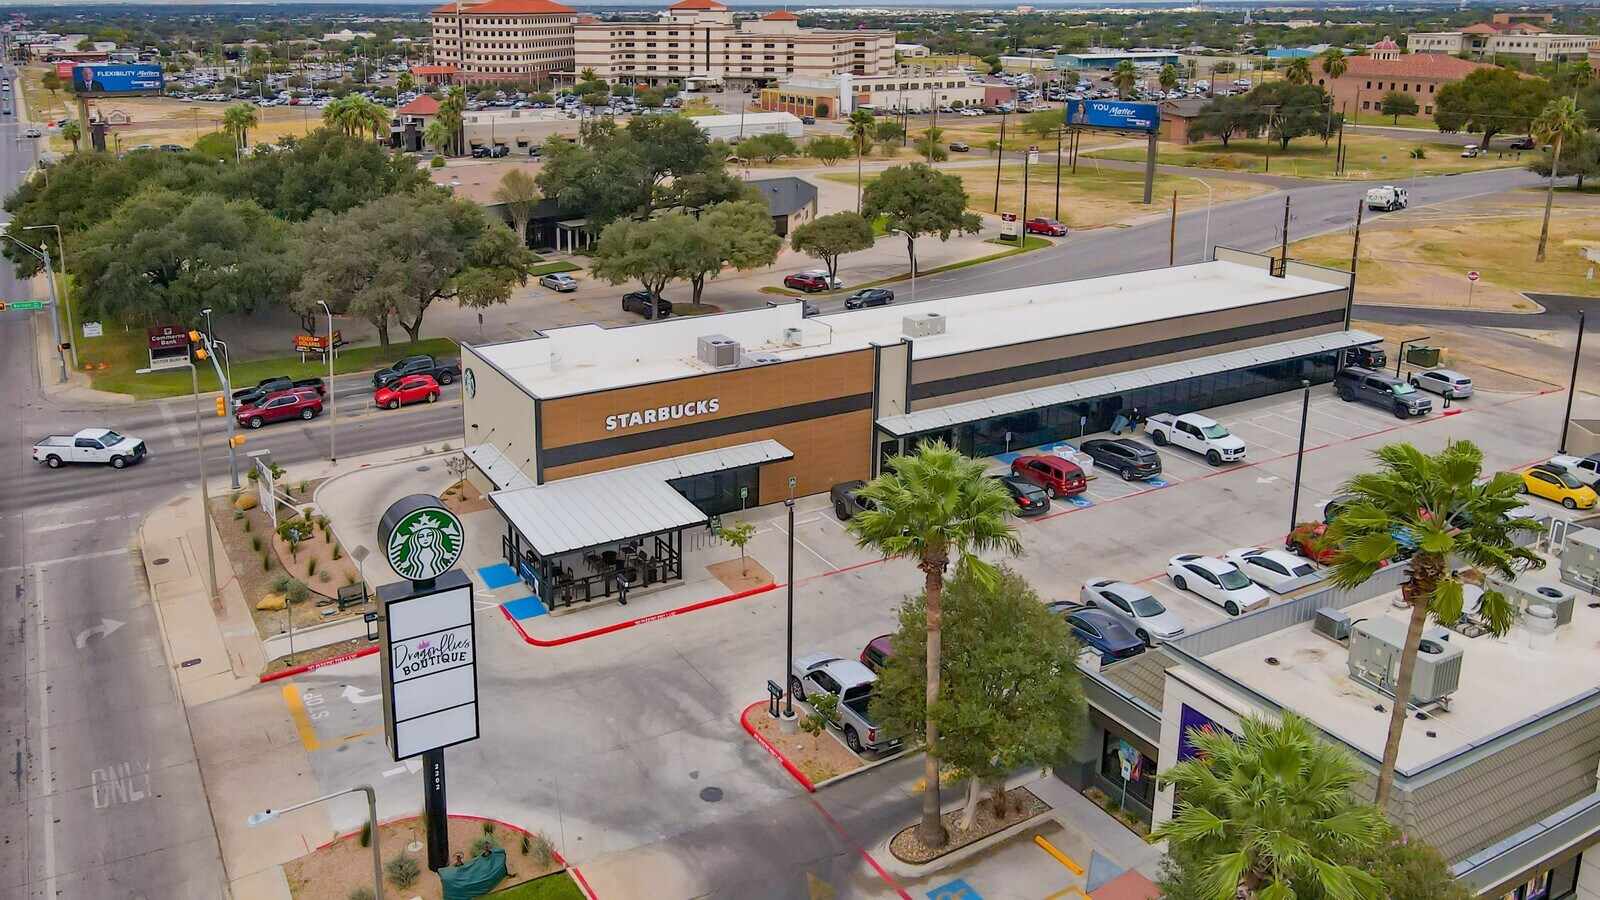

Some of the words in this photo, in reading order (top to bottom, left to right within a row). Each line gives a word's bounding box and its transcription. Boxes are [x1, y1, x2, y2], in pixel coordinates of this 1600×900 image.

[1093, 103, 1109, 111] YOU
[1109, 106, 1136, 116] Matter
[151, 333, 186, 342] Commerce
[605, 398, 720, 431] STARBUCKS
[393, 633, 470, 669] Dragonflies
[402, 651, 467, 676] BOUTIQUE
[302, 693, 330, 720] STOP
